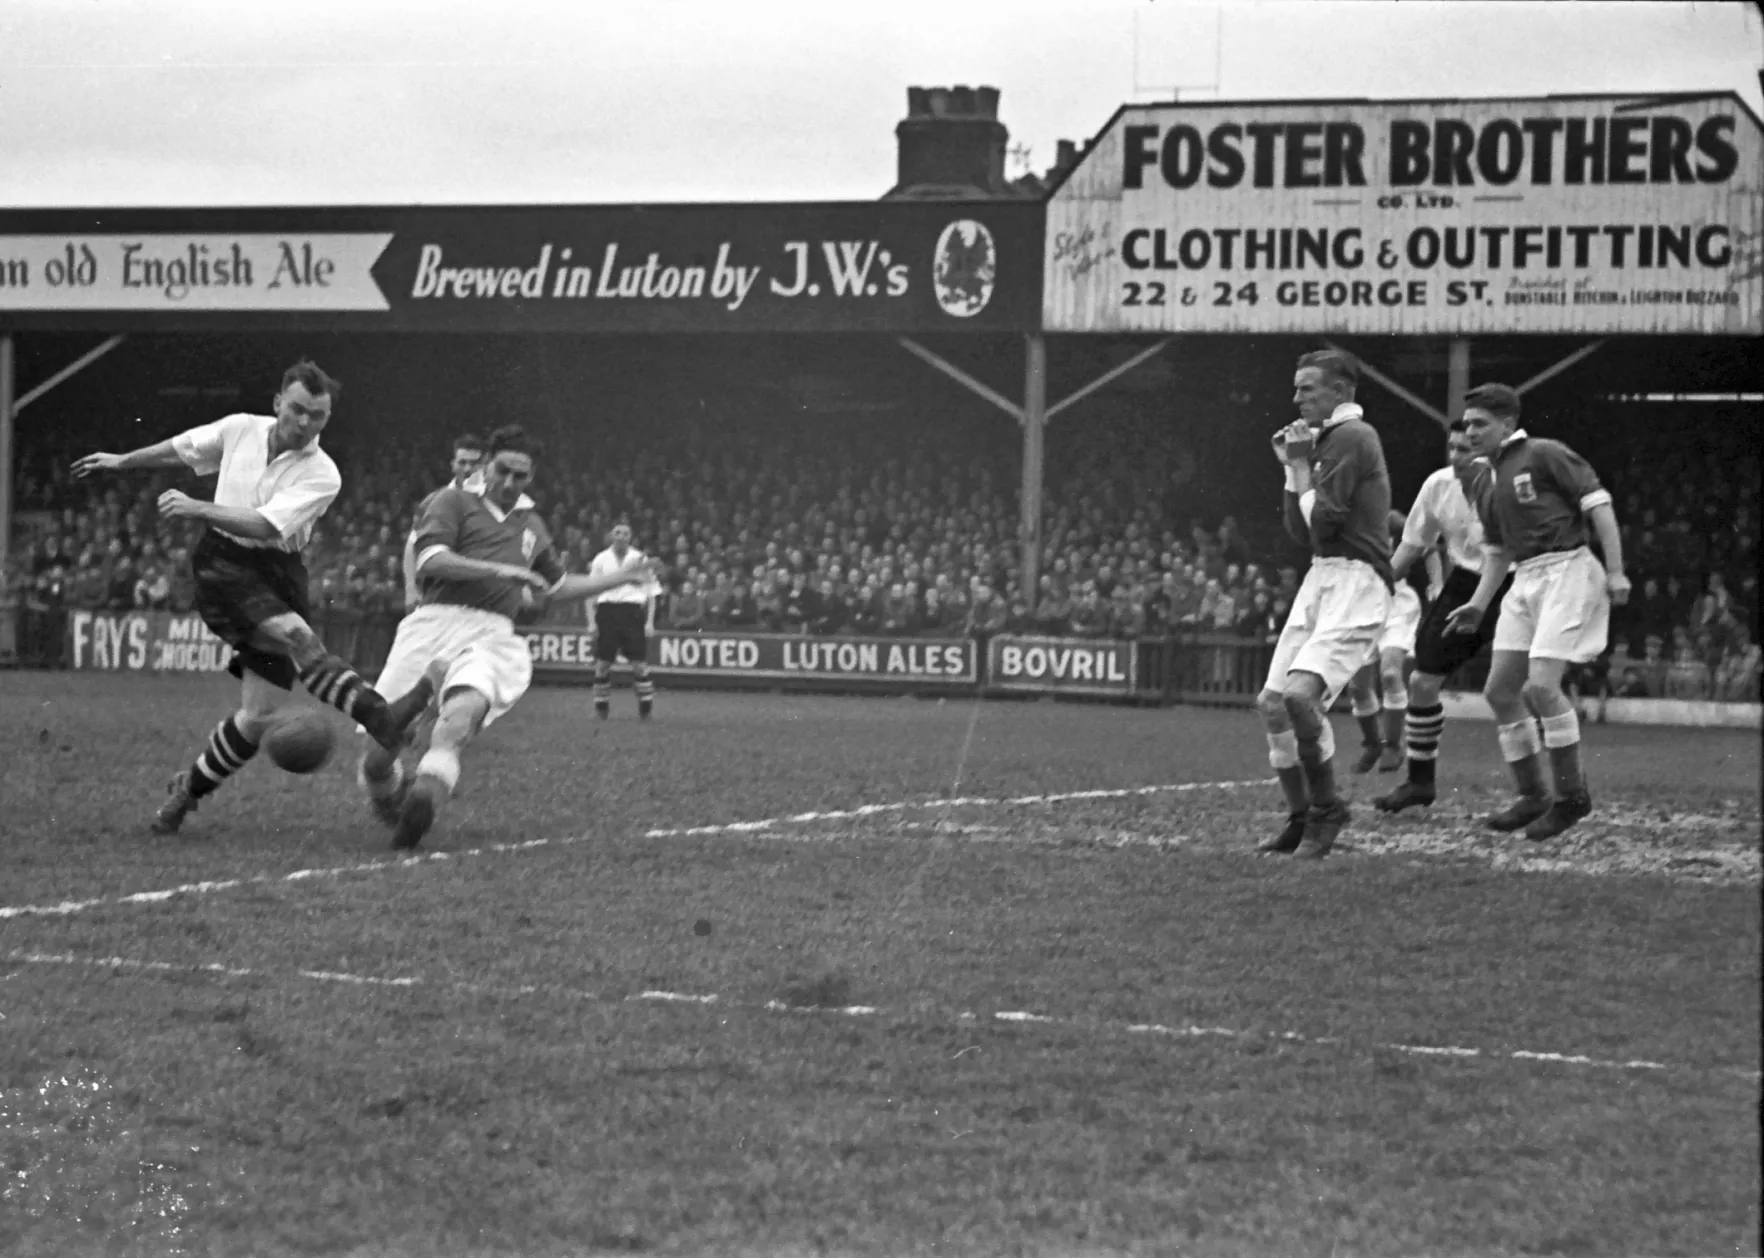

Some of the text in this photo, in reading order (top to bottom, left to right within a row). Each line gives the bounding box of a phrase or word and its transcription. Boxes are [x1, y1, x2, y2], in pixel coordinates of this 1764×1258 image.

[1122, 115, 1740, 190] FOSTER BROTHERS
[1121, 227, 1365, 271] CLOTHING
[1376, 239, 1399, 270] &
[1406, 223, 1733, 270] OUTFITTING
[44, 241, 98, 288] old
[121, 242, 254, 299] English
[266, 240, 336, 290] Ale
[411, 243, 552, 299] Brewed
[552, 248, 592, 299] in
[595, 242, 706, 299] Luton
[710, 242, 761, 312] by
[1121, 281, 1167, 307] 22
[1212, 281, 1260, 307] 24
[1276, 280, 1428, 307] GEORGE
[1446, 280, 1494, 307] ST.
[168, 618, 222, 641] MIL
[153, 640, 233, 672] CHOCOLA
[526, 633, 964, 675] GREE NOTED LUTON ALES
[1002, 646, 1125, 681] BOVRIL
